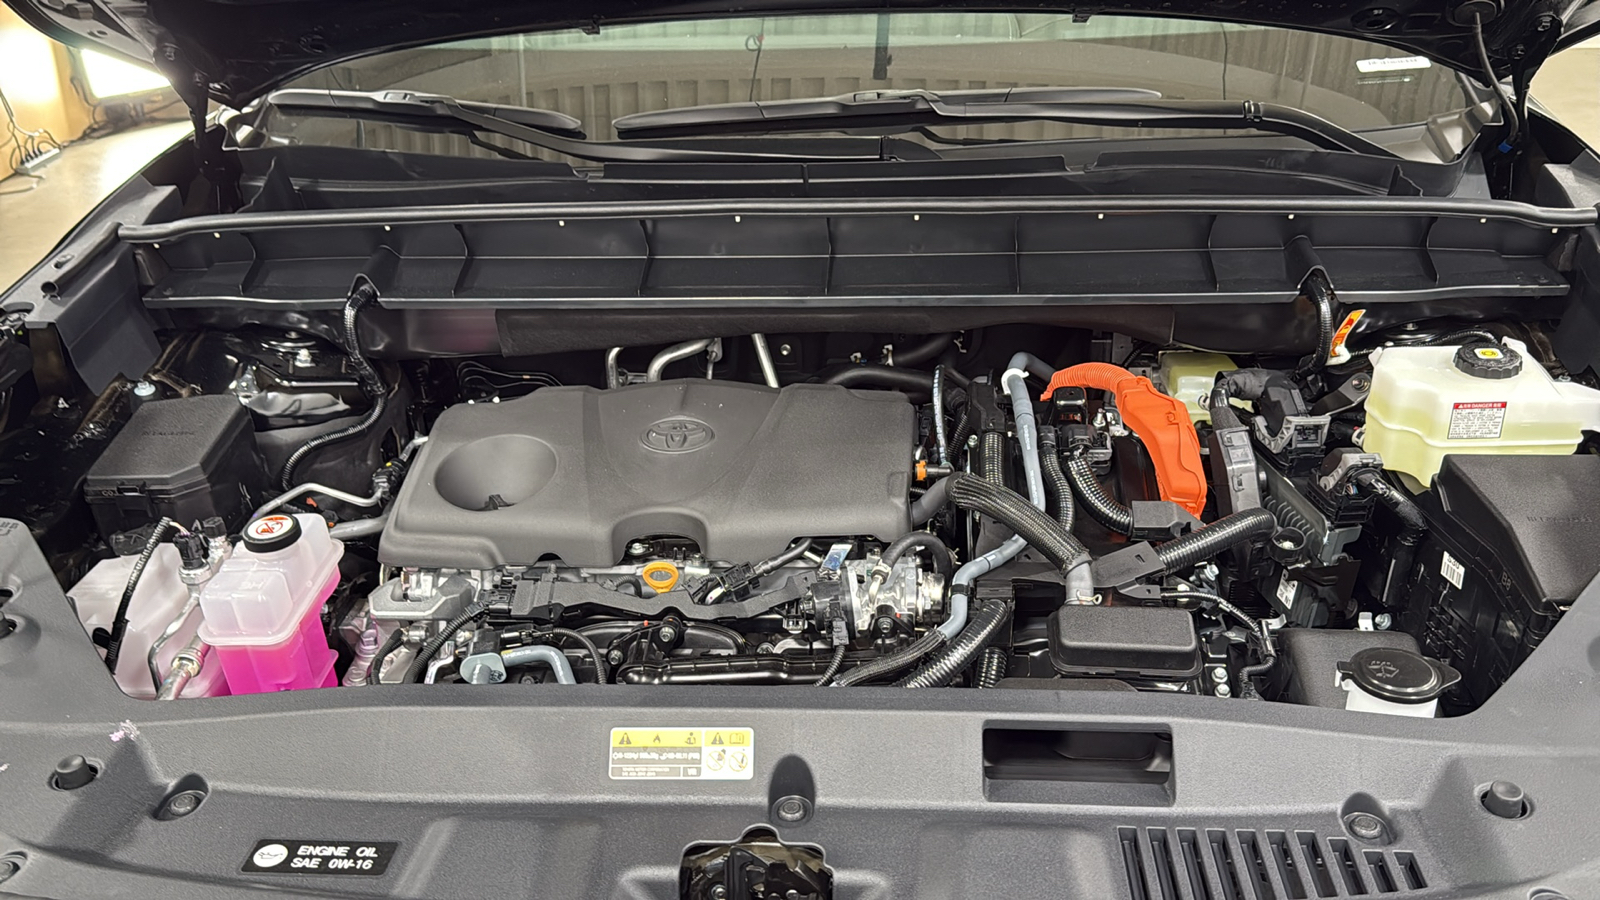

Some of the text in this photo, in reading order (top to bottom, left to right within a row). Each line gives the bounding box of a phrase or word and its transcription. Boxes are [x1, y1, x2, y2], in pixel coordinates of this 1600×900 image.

[297, 845, 378, 858] ENGINE OIL
[290, 857, 373, 870] SAE 0W-16
